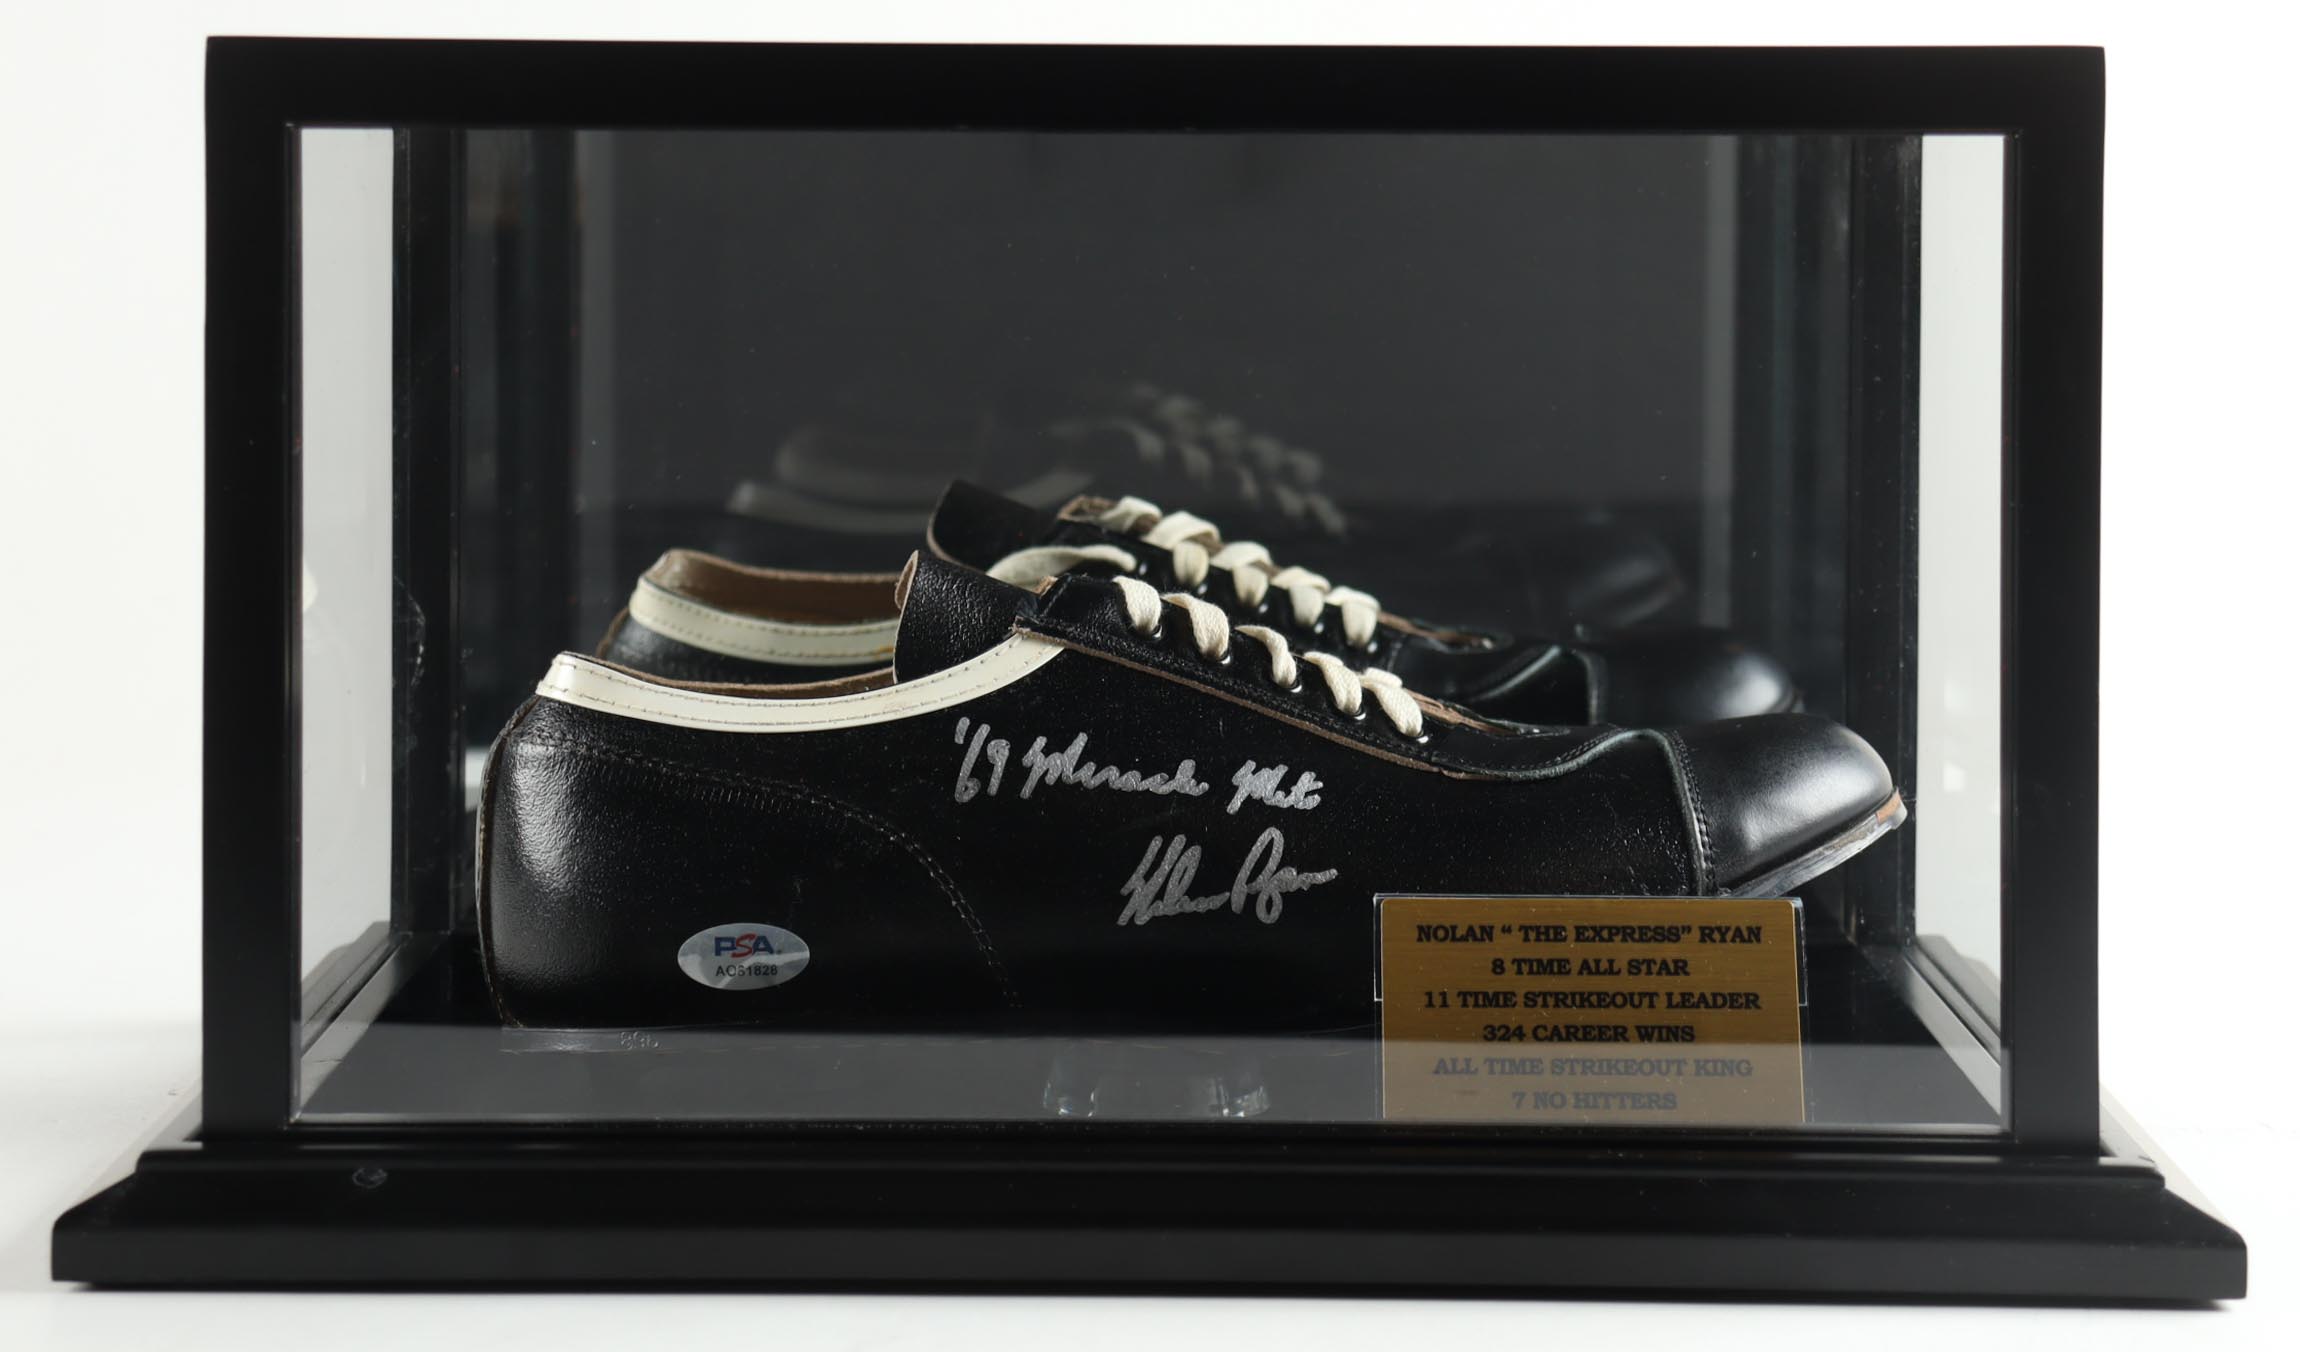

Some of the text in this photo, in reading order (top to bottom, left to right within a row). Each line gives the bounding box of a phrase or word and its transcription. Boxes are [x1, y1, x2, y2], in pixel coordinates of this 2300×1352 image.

[1416, 925, 1494, 943] NOLAN
[1518, 925, 1567, 943] THE
[1698, 926, 1762, 943] RYAN
[714, 933, 774, 958] PSA
[1491, 958, 1690, 976] 8 TIME ALL STAR
[1424, 991, 1762, 1010] 11 TIME STRIKEOUT LEADER
[1483, 1024, 1695, 1042] 324 CAREER WINS
[1433, 1058, 1753, 1077] ALL TIME STRIKEOUT KING
[1512, 1091, 1678, 1110] 7 NO HITTERS
